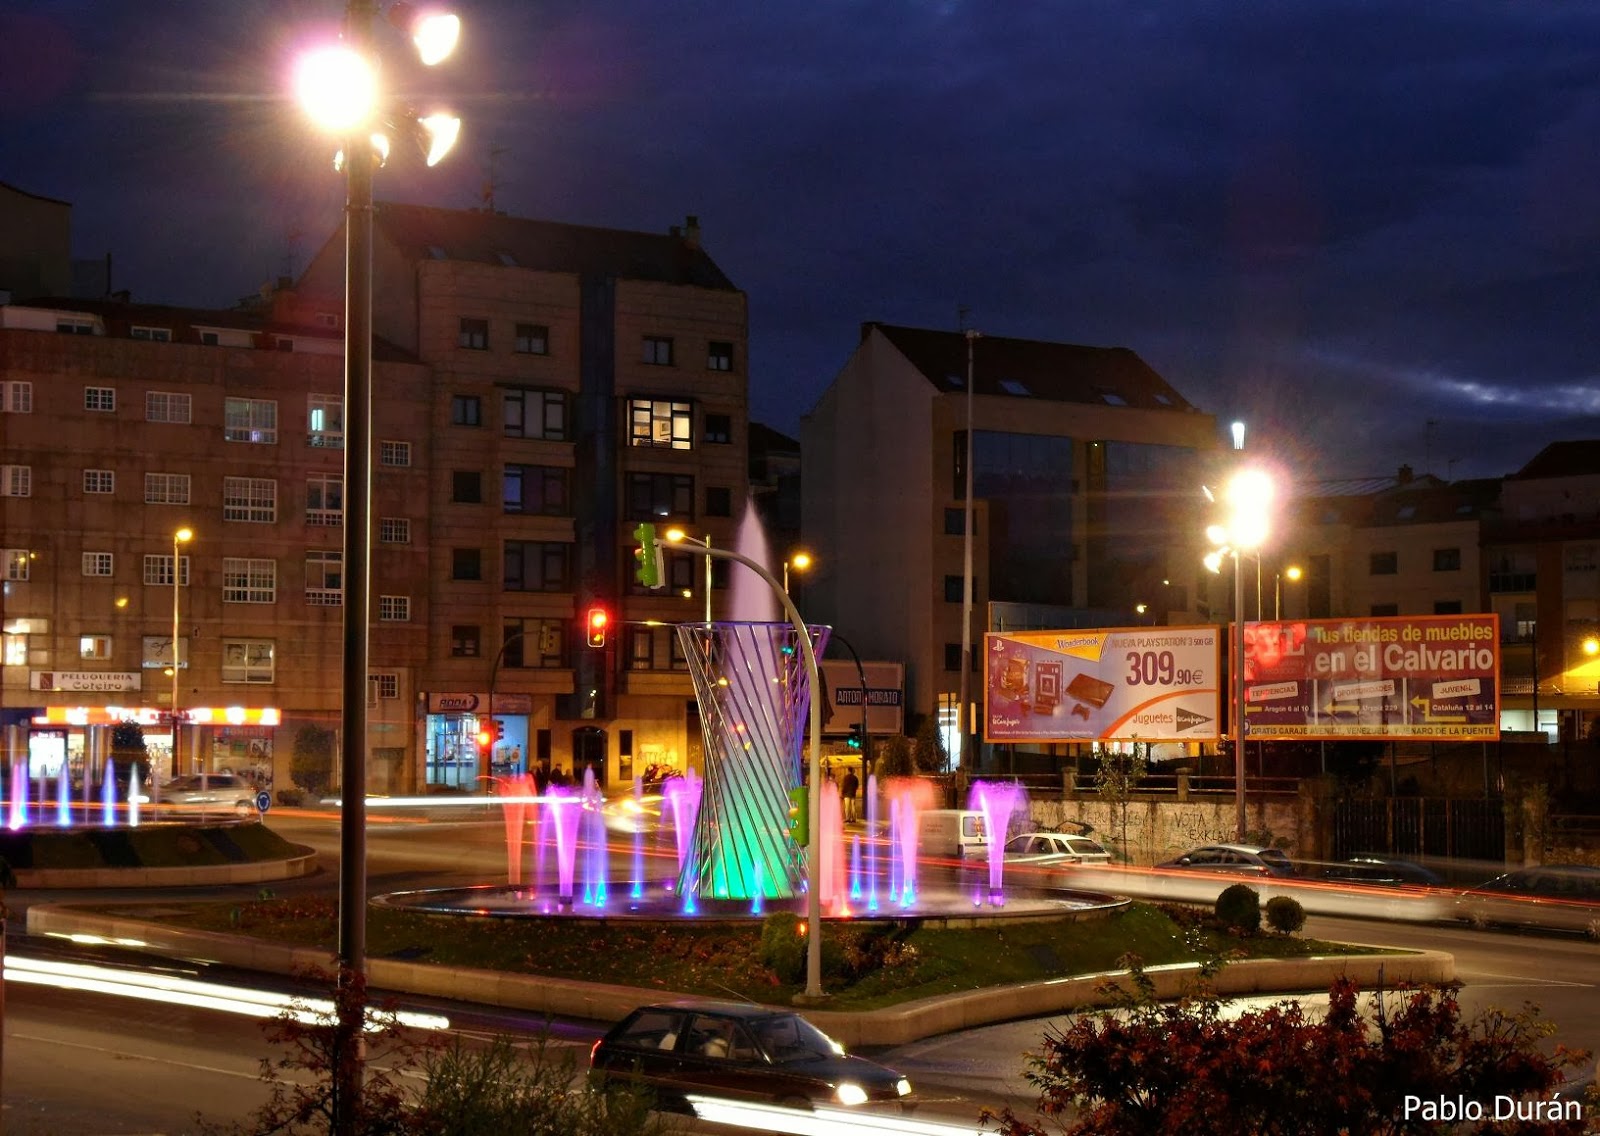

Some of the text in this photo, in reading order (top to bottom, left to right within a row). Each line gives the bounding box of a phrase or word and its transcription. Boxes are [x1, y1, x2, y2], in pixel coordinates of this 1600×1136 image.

[1314, 627, 1340, 644] Tus
[1344, 625, 1398, 643] tiendas
[1402, 625, 1422, 642] de
[1426, 622, 1493, 641] muebles
[1112, 638, 1136, 648] NUEVA
[1137, 637, 1186, 648] PLAYSTATION
[1314, 643, 1494, 673] en el Calvario
[61, 673, 133, 681] PELUQUERIA
[1440, 685, 1473, 694] JUVENIL
[1132, 713, 1174, 725] Juguetes
[1251, 727, 1276, 735] GRATIS
[1435, 727, 1446, 735] DE
[1449, 727, 1460, 735] LA
[1462, 727, 1494, 735] FUENTE
